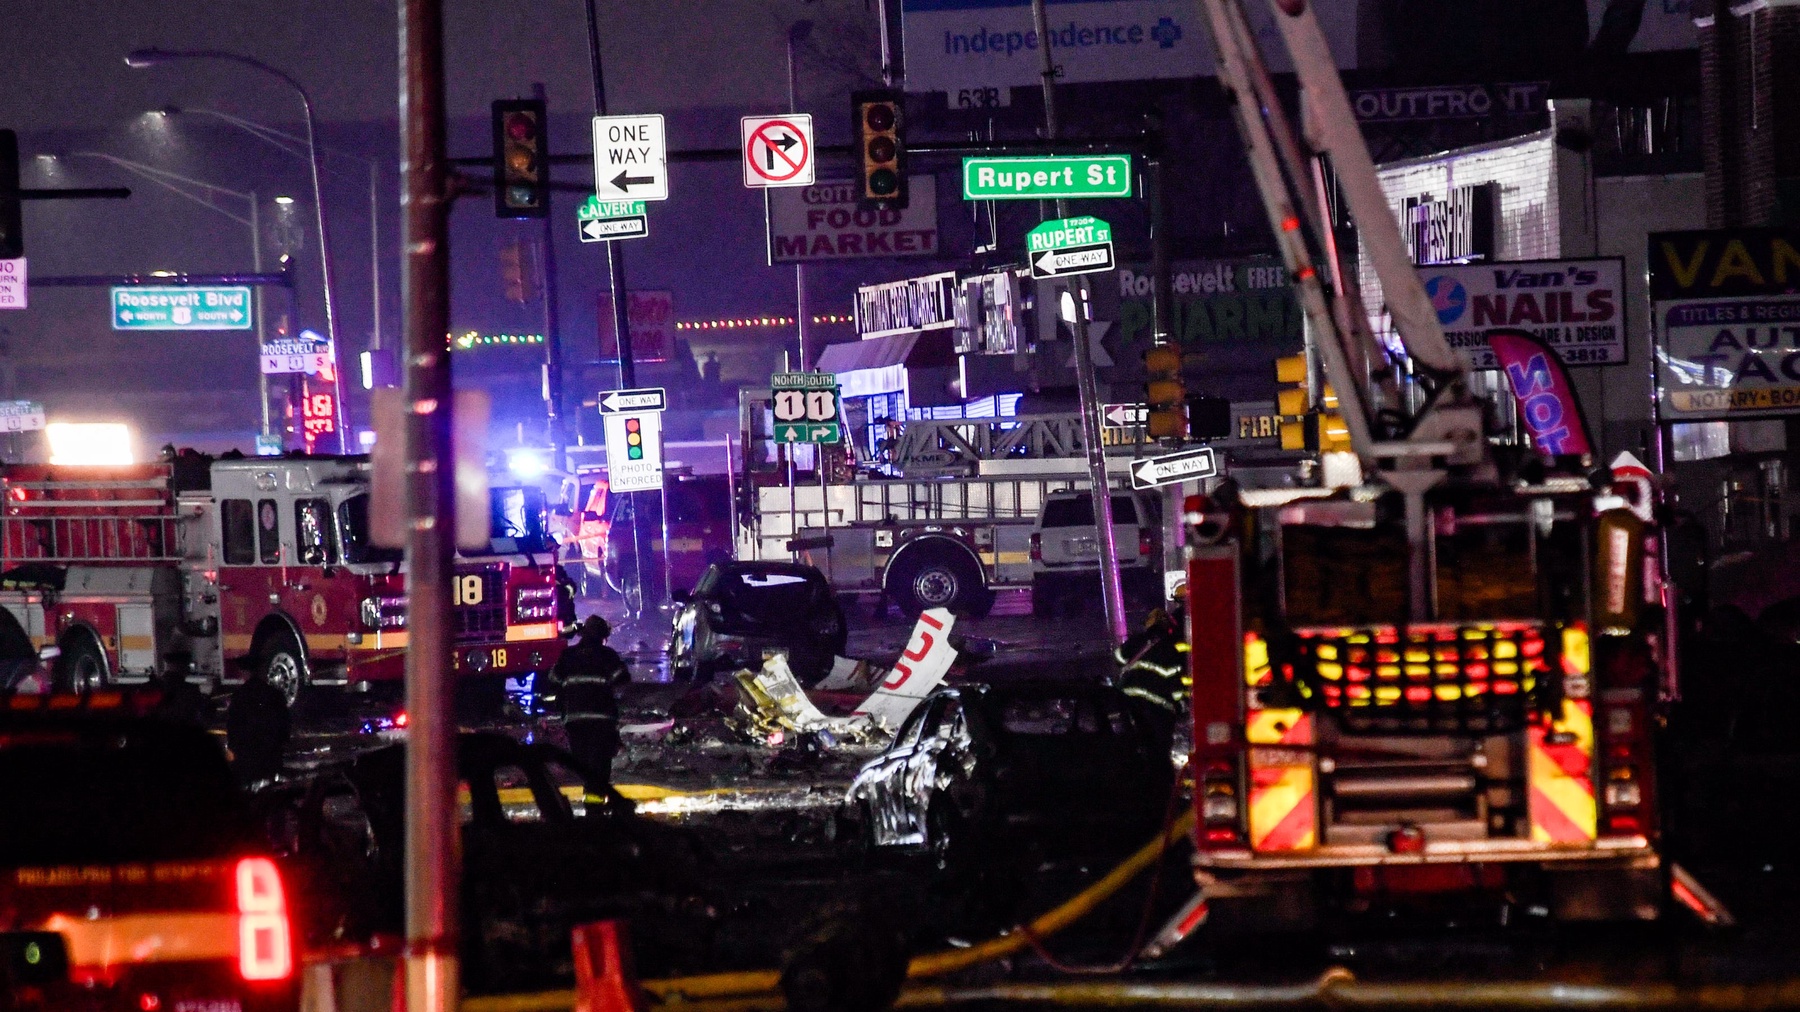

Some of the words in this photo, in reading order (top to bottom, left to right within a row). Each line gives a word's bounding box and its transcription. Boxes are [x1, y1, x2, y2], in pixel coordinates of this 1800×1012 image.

[608, 124, 650, 143] ONE
[608, 147, 651, 165] WAY
[978, 166, 1073, 191] Rupert
[1087, 164, 1116, 186] St
[579, 200, 635, 218] CALVERT
[635, 204, 645, 213] ST
[600, 223, 619, 233] ONE
[620, 221, 639, 230] WAY
[807, 208, 902, 230] FOOD
[774, 229, 936, 257] MARKET
[1031, 226, 1094, 249] RUPERT
[1096, 229, 1109, 241] ST
[1055, 254, 1078, 267] ONE
[1081, 251, 1103, 263] WAY
[1119, 264, 1234, 297] Roevelt
[1247, 266, 1284, 289] FREE
[1494, 266, 1599, 289] Van's
[119, 291, 200, 306] Roosevelt
[205, 291, 243, 306] Blvd
[1472, 289, 1615, 326] NAILS
[1680, 307, 1736, 321] TITLES
[1577, 325, 1616, 342] DESIGN
[262, 342, 314, 355] ROOSEVELT
[269, 359, 278, 368] N
[316, 357, 324, 366] S
[774, 375, 804, 386] NORTH
[806, 375, 833, 386] SOUTH
[619, 397, 637, 406] ONE
[640, 395, 658, 404] WAY
[784, 395, 793, 415] 1
[814, 395, 823, 416] 1
[621, 463, 653, 473] PHOTO
[1156, 463, 1179, 476] ONE
[1182, 459, 1205, 471] WAY
[614, 475, 662, 487] ENFORCED
[453, 575, 483, 606] 18
[491, 648, 507, 668] 18
